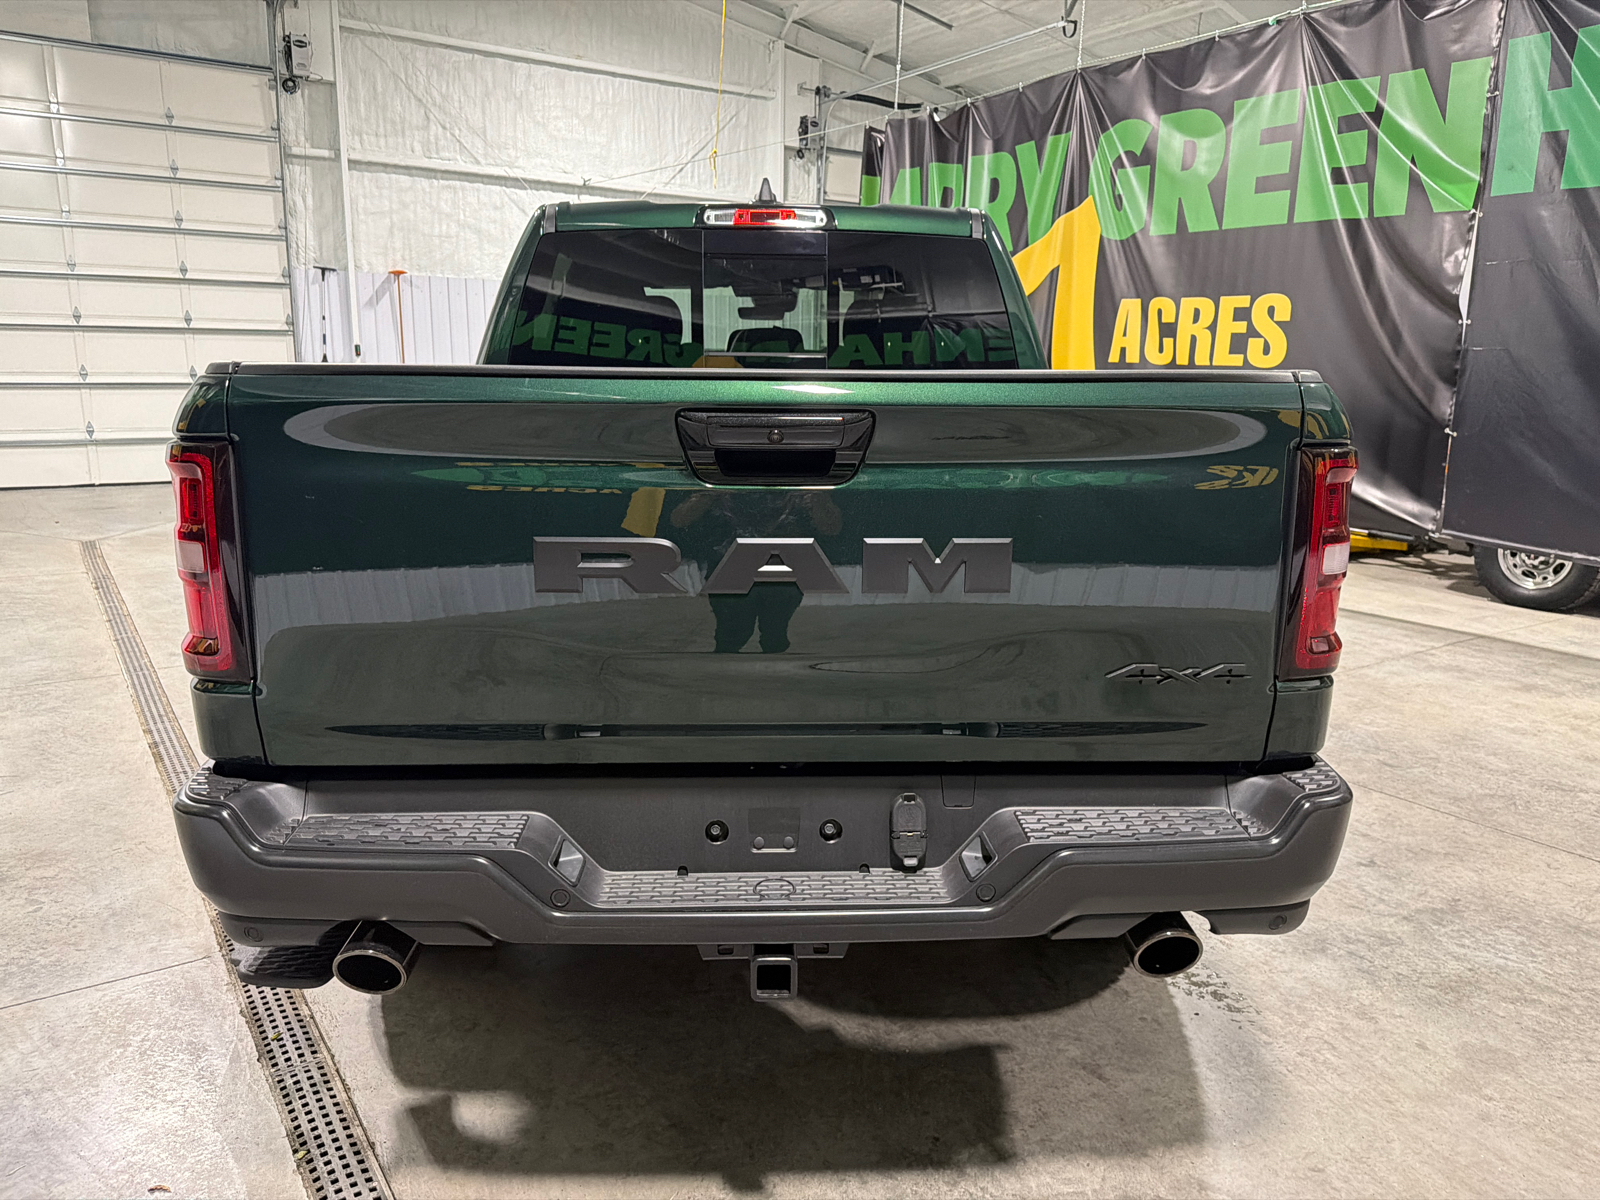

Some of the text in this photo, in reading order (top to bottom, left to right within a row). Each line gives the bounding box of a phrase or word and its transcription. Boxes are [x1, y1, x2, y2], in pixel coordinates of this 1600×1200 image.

[1088, 56, 1492, 240] GREEN
[1108, 293, 1292, 368] ACRES
[533, 536, 1014, 594] RAM
